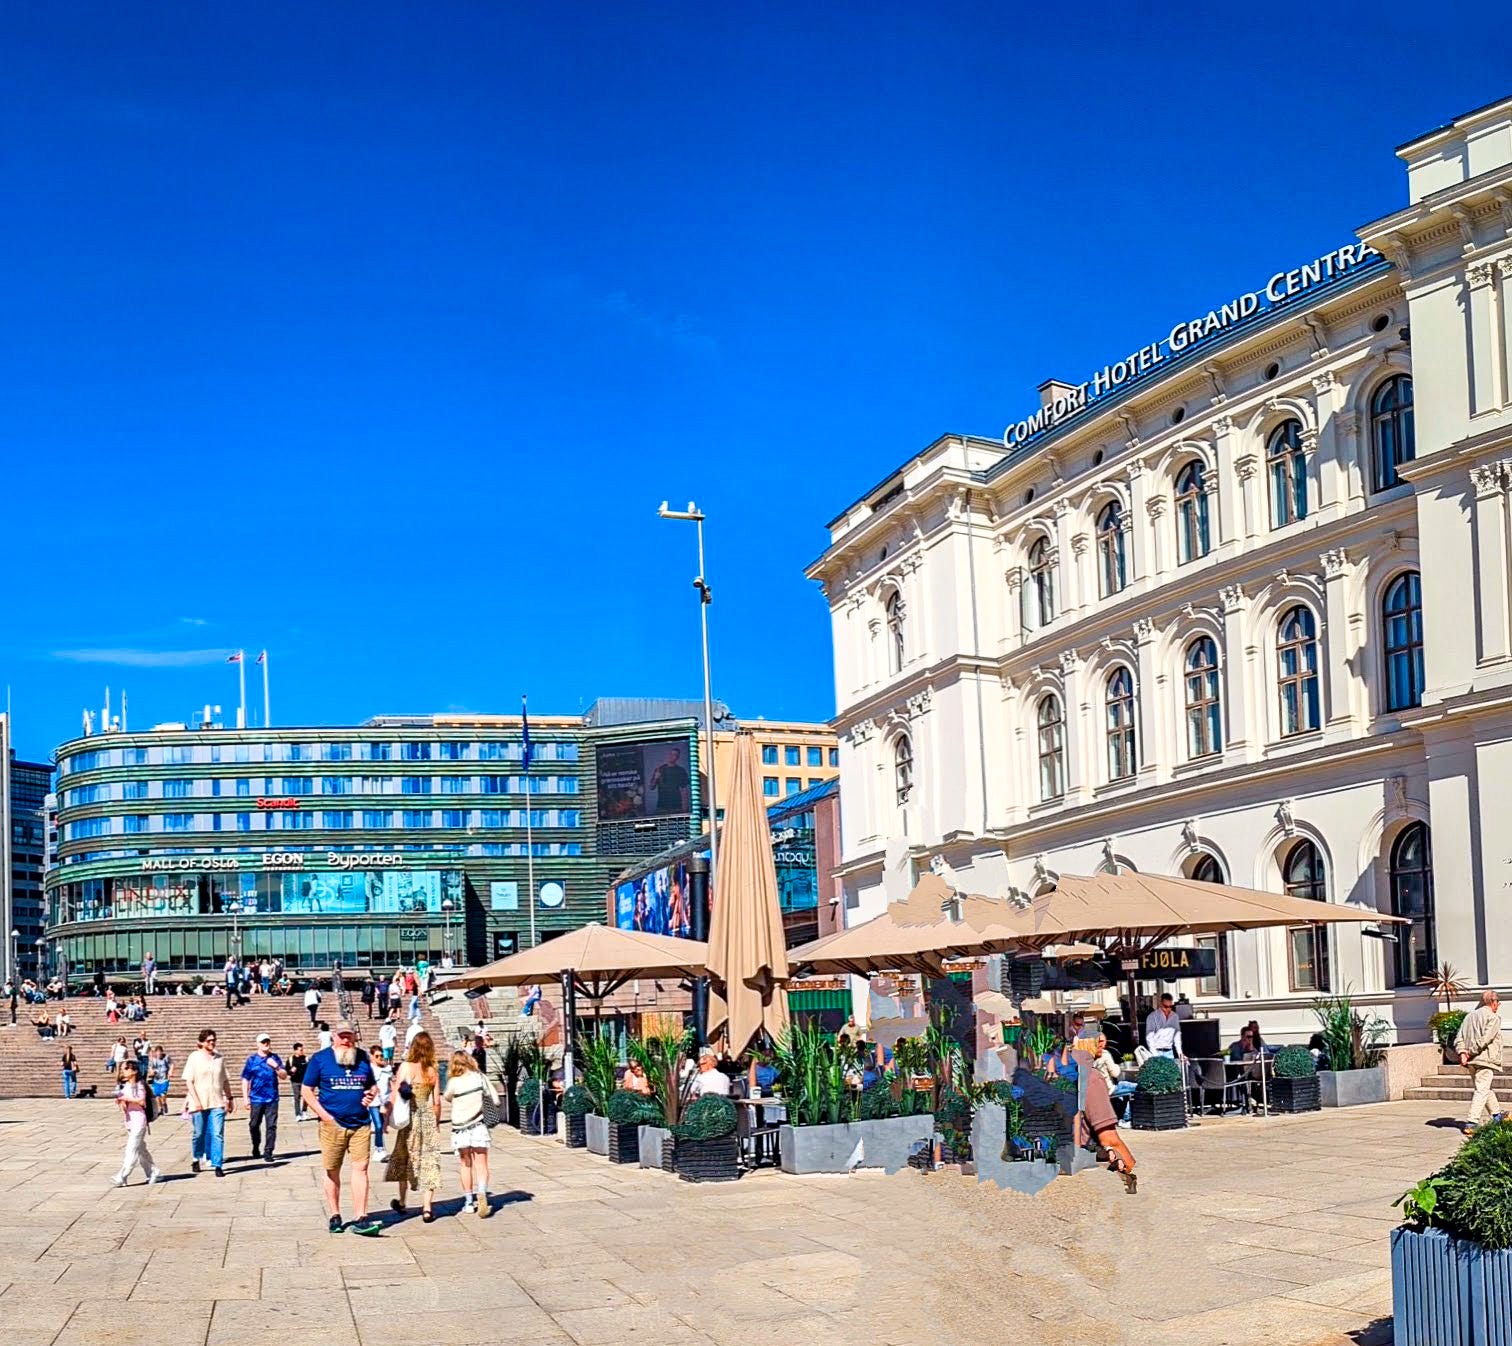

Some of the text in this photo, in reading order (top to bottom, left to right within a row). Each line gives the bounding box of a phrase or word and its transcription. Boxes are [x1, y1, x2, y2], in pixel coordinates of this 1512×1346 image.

[1003, 382, 1088, 449] COMFORT
[1093, 343, 1163, 396] HOTEL
[1169, 293, 1258, 351] GRAND
[256, 798, 299, 808] Scandic
[142, 857, 239, 870] MALL OF OSLO
[262, 853, 304, 865] EGON
[327, 852, 403, 869] Byporten
[1142, 951, 1189, 969] FJØLA
